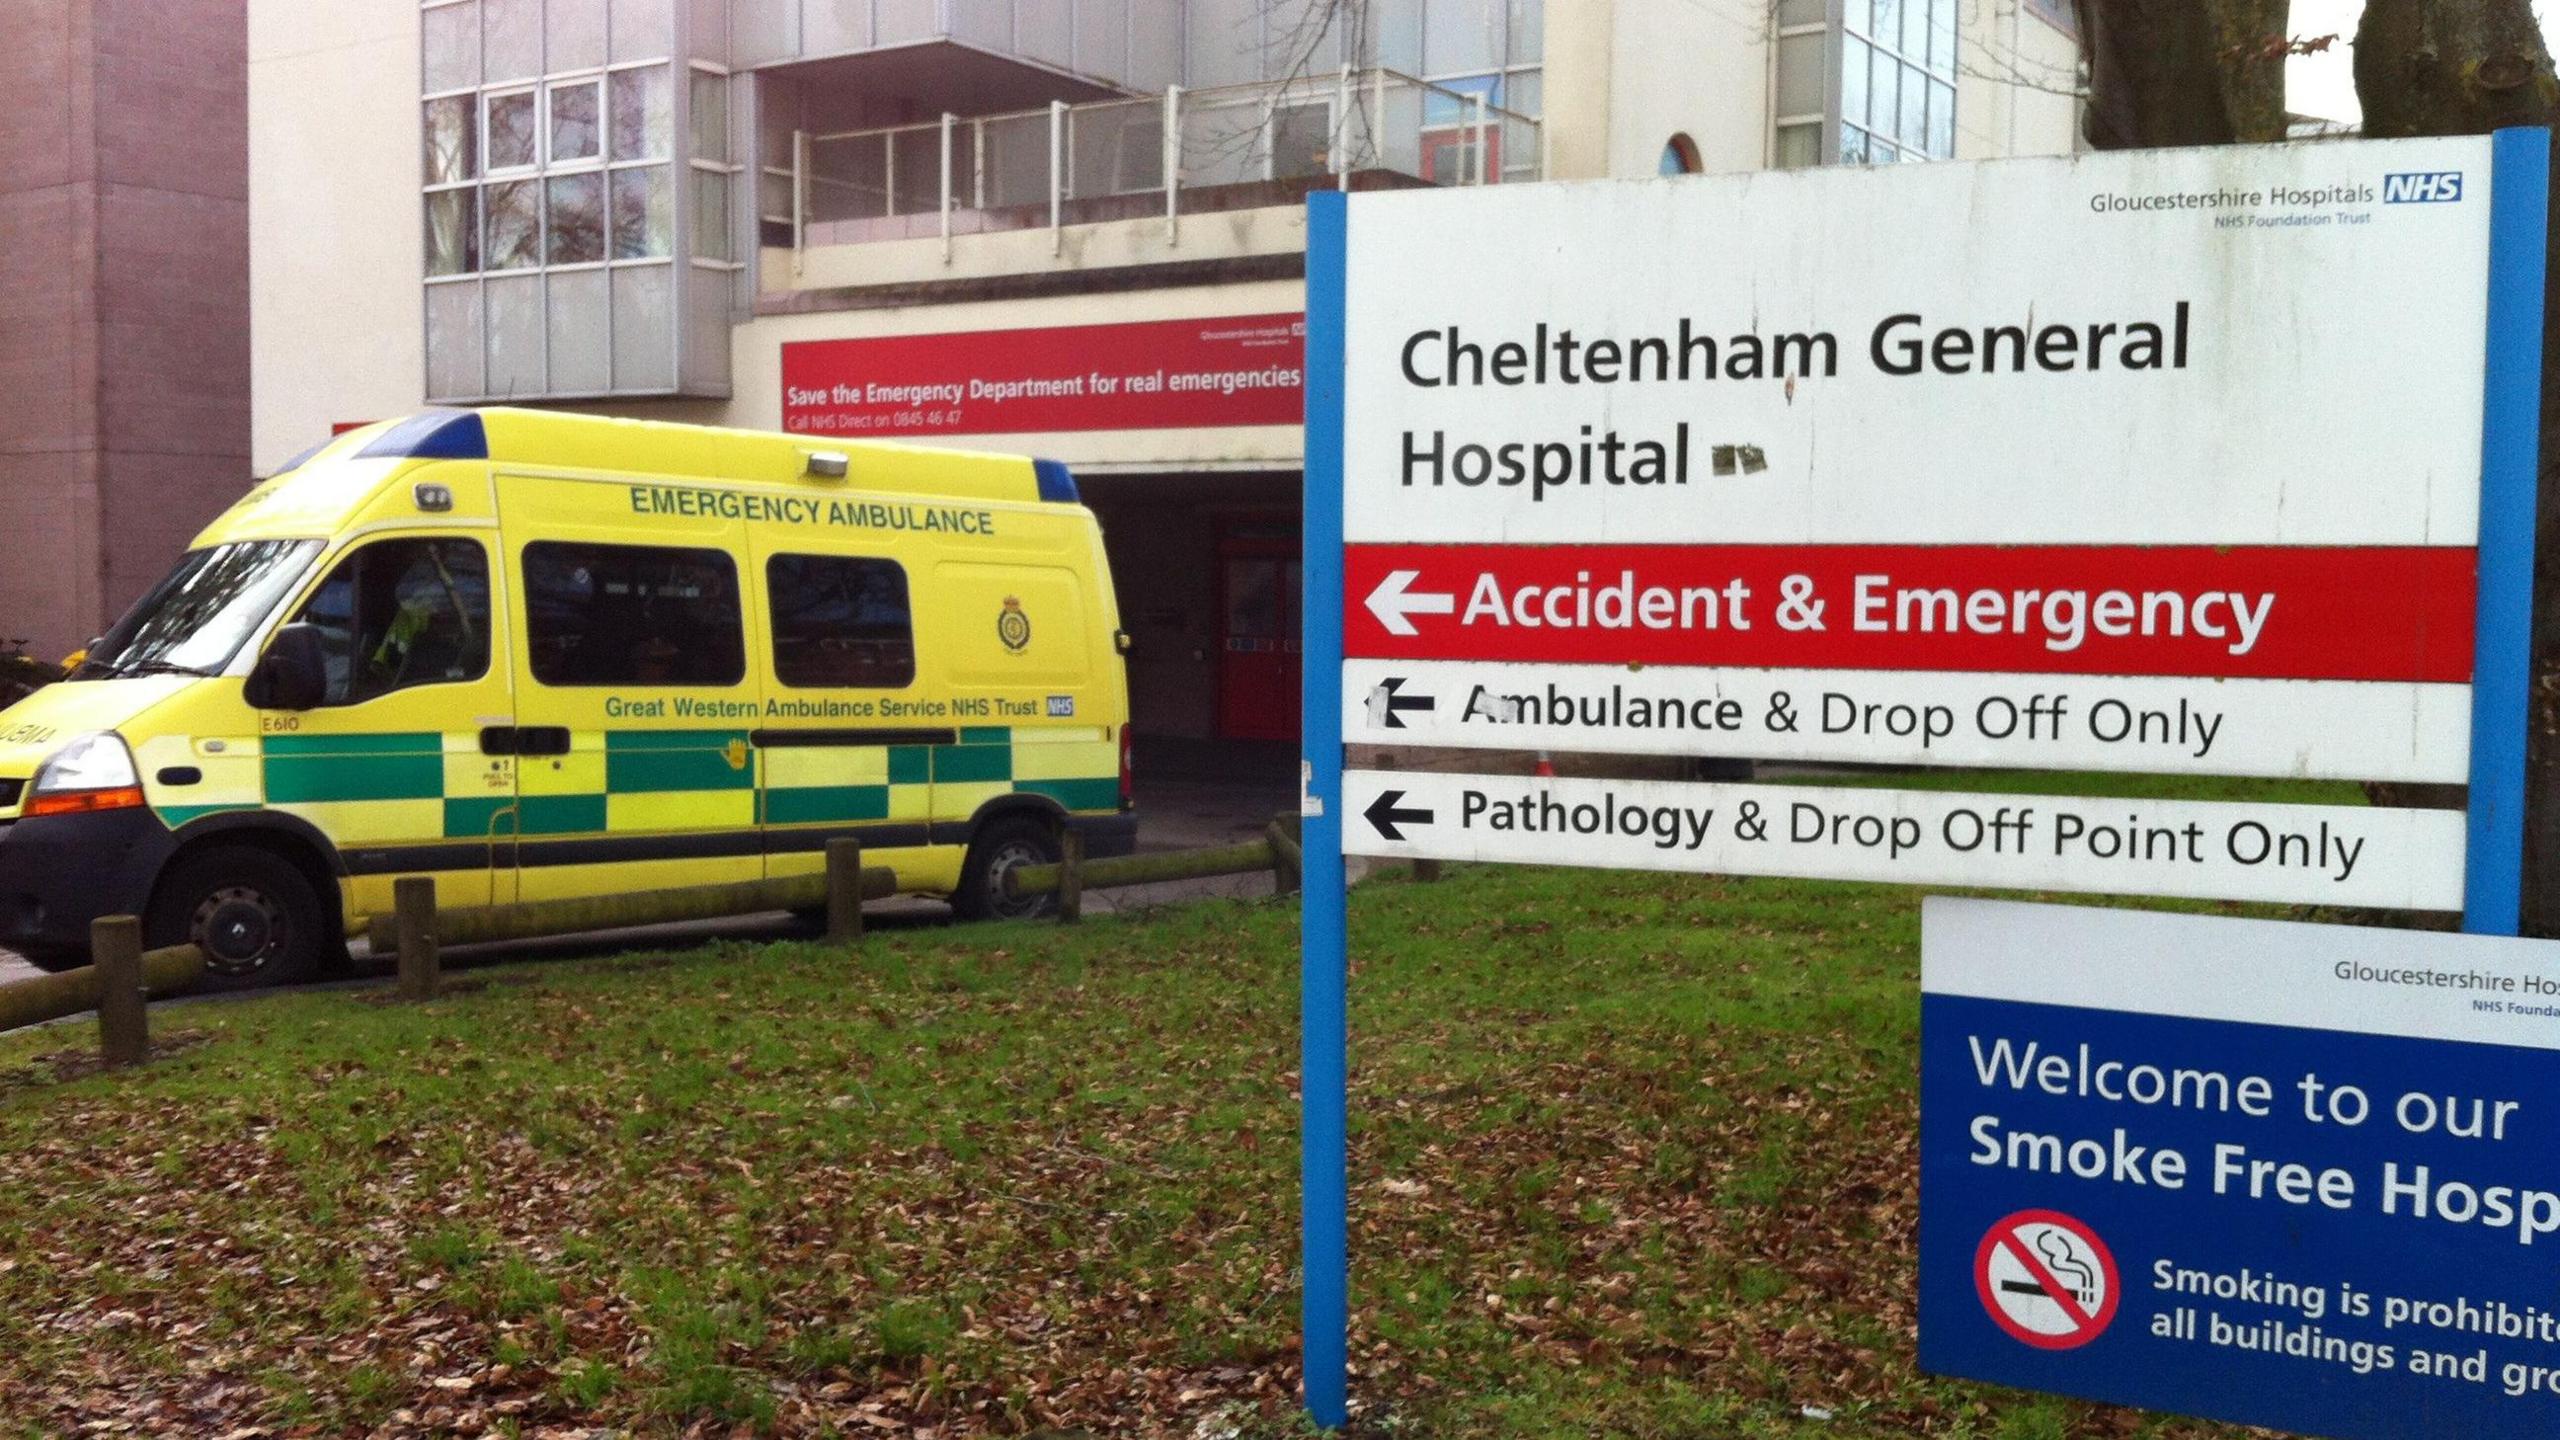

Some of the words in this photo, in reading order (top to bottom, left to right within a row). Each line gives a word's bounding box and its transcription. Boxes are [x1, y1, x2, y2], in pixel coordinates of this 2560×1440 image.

[2090, 185, 2262, 213] Gloucestershire
[2270, 182, 2374, 209] Hospitals
[2385, 173, 2461, 203] NHS
[2214, 216, 2244, 229] NHS
[2248, 213, 2331, 228] Foundation
[2336, 211, 2371, 225] Trust
[1400, 317, 1838, 389] Cheltenham
[1868, 301, 2190, 378] General
[788, 385, 827, 407] Save
[832, 383, 861, 405] the
[866, 381, 964, 407] Emergency
[969, 374, 1083, 403] Department
[1089, 371, 1119, 395] for
[1125, 369, 1163, 393] real
[1168, 363, 1301, 395] emergencies
[788, 414, 810, 430] Call
[839, 411, 872, 428] Direct
[1401, 421, 1690, 503] Hospital
[630, 487, 820, 524] EMERGENCY
[829, 502, 995, 535] AMBULANCE
[1461, 570, 1751, 631] Accident
[1775, 573, 1827, 632] &
[1854, 574, 2275, 656] Emergency
[605, 697, 664, 718] Great
[673, 698, 758, 718] Western
[766, 697, 874, 718] Ambulance
[880, 697, 946, 717] Service
[952, 698, 989, 717] NHS
[995, 698, 1037, 717] Trust
[1047, 696, 1073, 716] NHS
[1461, 683, 1742, 732] Ambulance
[1764, 690, 1799, 733] &
[1821, 691, 1954, 748] Drop
[1975, 694, 2068, 741] Off
[2088, 698, 2223, 758] Only
[1462, 790, 1713, 851] Pathology
[1733, 800, 1768, 843] &
[1790, 802, 1921, 859] Drop
[1942, 808, 2034, 855] Off
[2054, 813, 2204, 864] Point
[2226, 820, 2365, 882] Only
[2334, 960, 2516, 992] Gloucestershire
[2472, 999, 2503, 1013] NHS
[1968, 1035, 2273, 1117] Welcome
[2297, 1072, 2369, 1127] to
[2396, 1090, 2519, 1141] our
[1969, 1115, 2187, 1189] Smoke
[2213, 1144, 2355, 1210] Free
[2153, 1258, 2325, 1319] Smoking
[2341, 1282, 2370, 1317] is
[2384, 1296, 2560, 1343] prohibit
[2151, 1307, 2196, 1341] all
[2210, 1312, 2395, 1375] buildings
[2408, 1349, 2487, 1383] and
